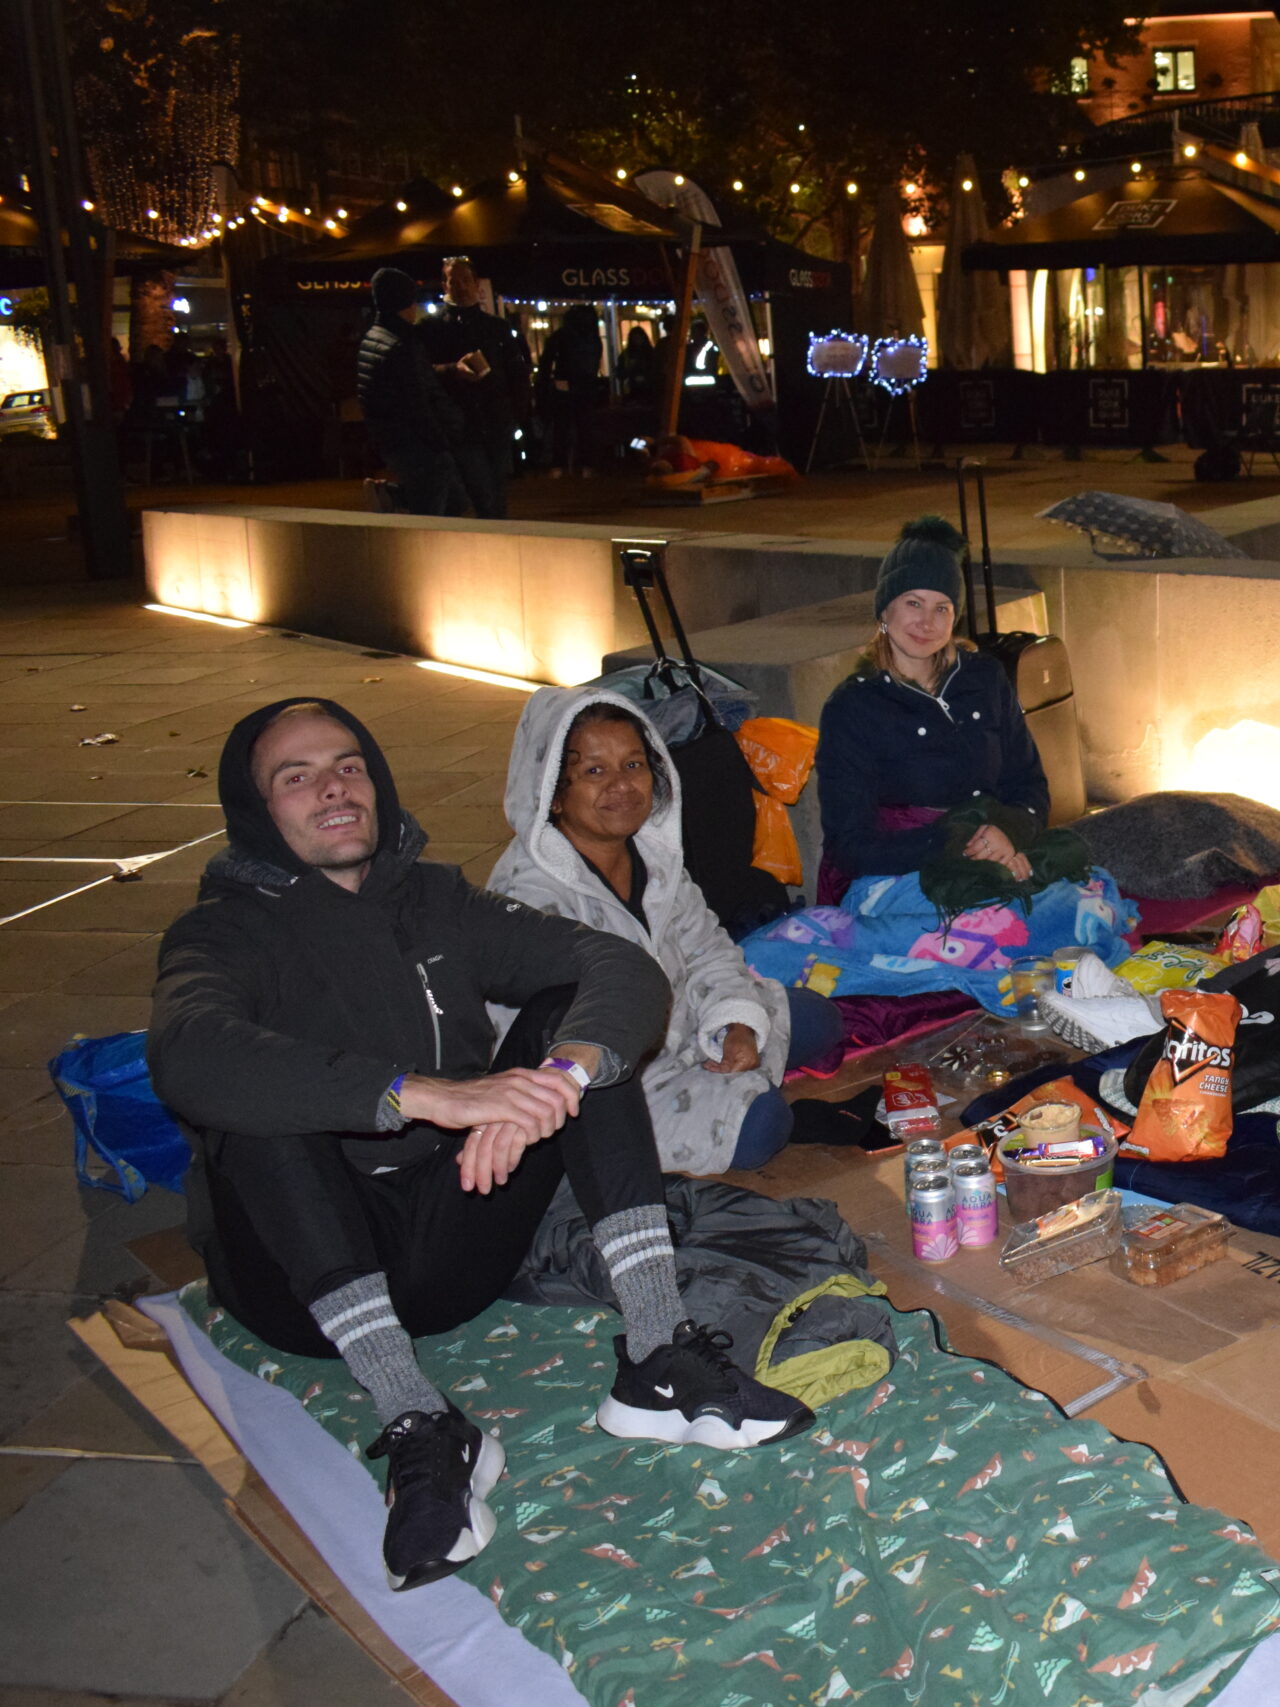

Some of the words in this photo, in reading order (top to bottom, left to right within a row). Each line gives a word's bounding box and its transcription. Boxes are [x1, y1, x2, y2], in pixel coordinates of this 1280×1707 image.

[1205, 1074, 1230, 1085] TANGY
[1199, 1081, 1228, 1093] CHEESE
[961, 1193, 992, 1204] AQUA
[961, 1201, 993, 1211] LIBRA
